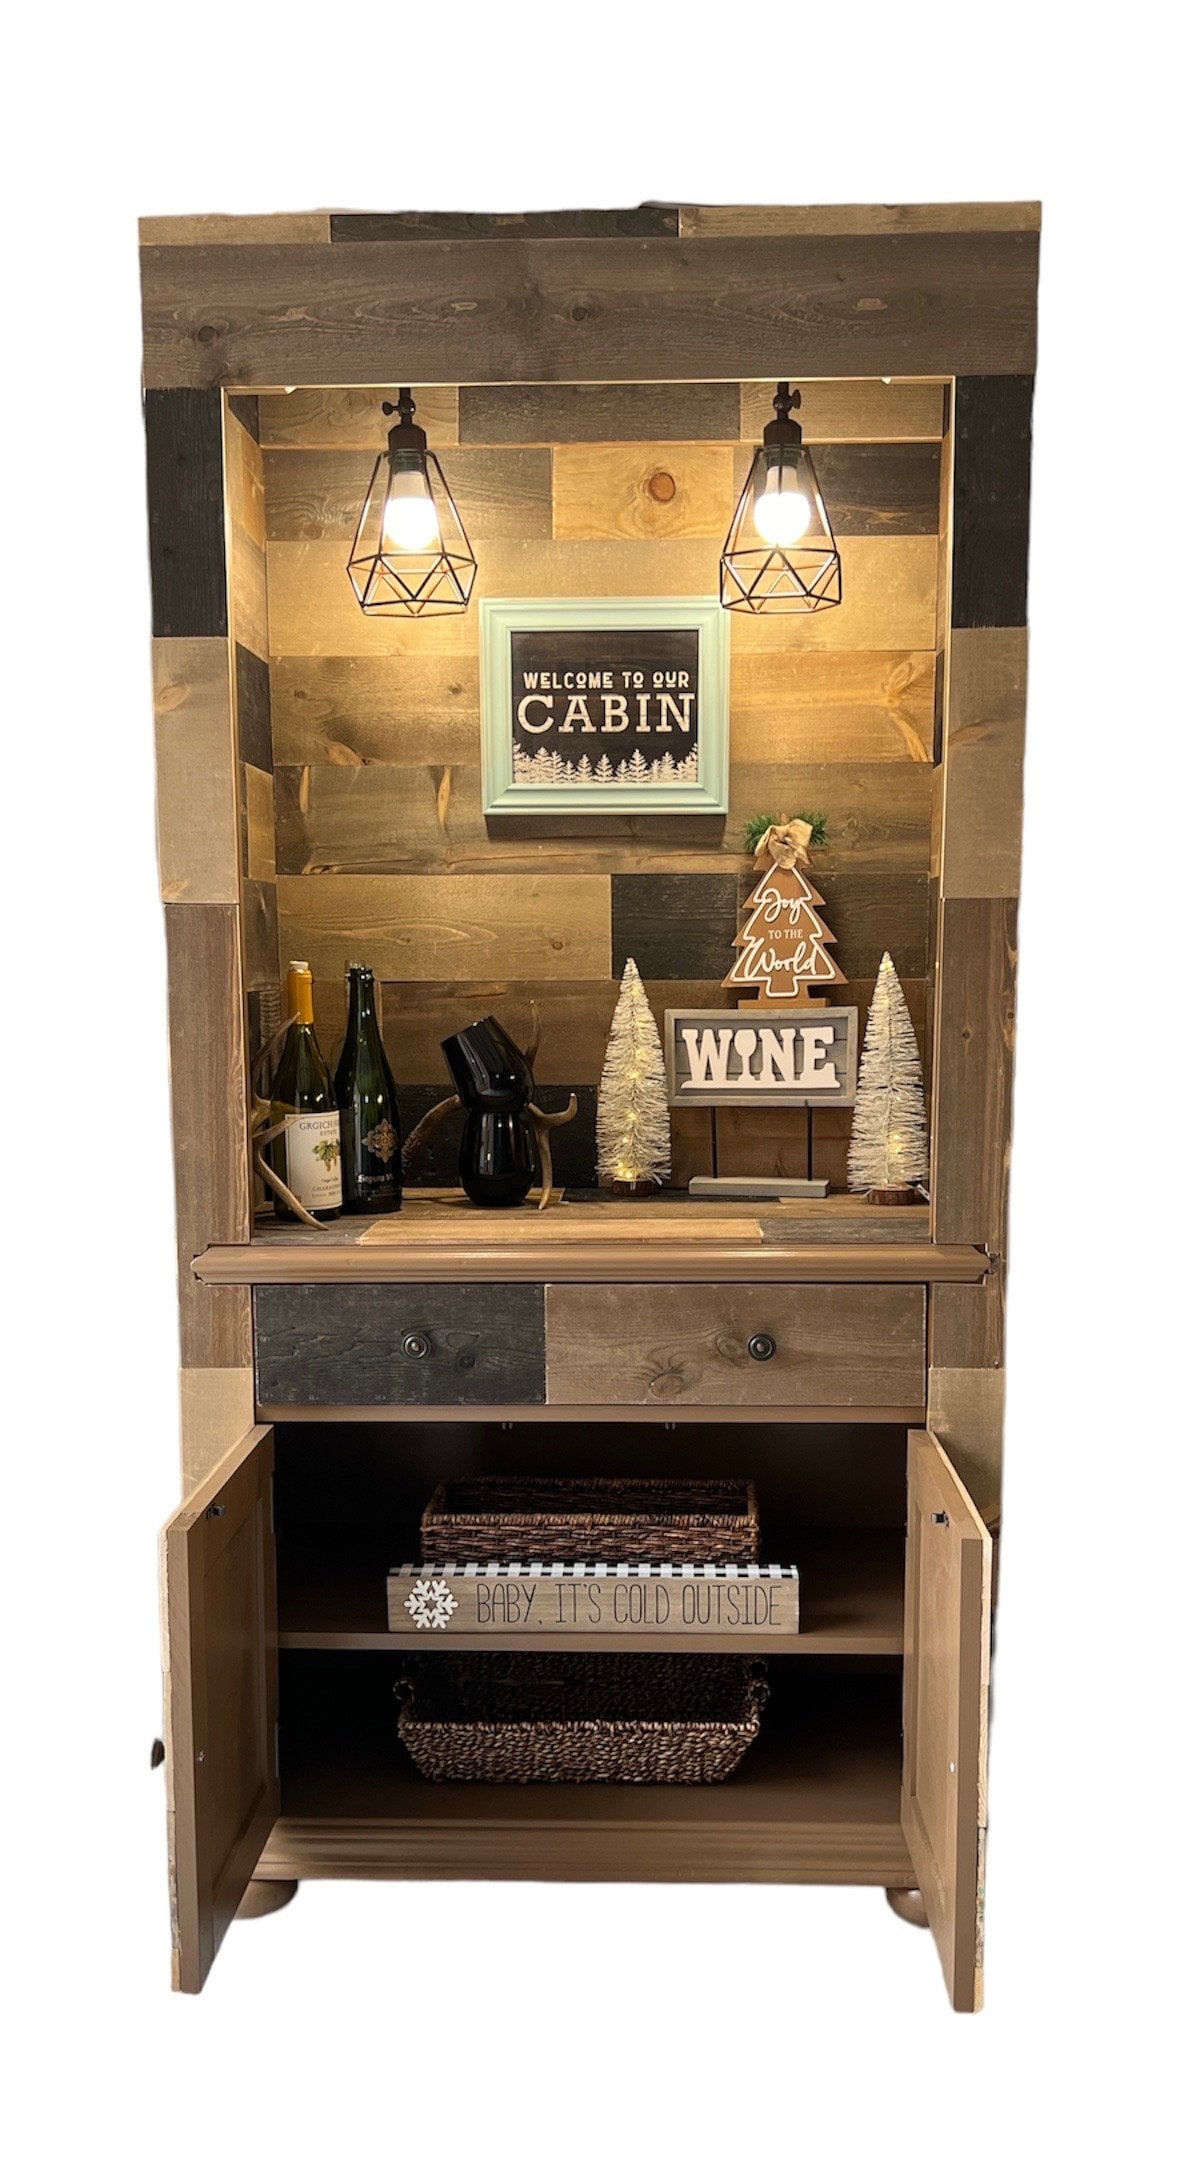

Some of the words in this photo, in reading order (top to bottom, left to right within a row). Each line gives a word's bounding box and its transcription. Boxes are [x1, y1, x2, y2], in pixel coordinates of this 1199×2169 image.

[523, 671, 614, 690] WELCOME
[622, 671, 645, 689] TO
[652, 671, 690, 689] OUR
[517, 692, 696, 734] CABIN
[761, 887, 801, 925] Joy
[767, 929, 782, 939] TO
[783, 928, 804, 939] THE
[743, 937, 818, 979] World
[681, 1026, 837, 1086] WINE
[554, 1583, 602, 1625] IT'S
[613, 1583, 671, 1625] COLD
[681, 1584, 783, 1626] OUTSIDE
